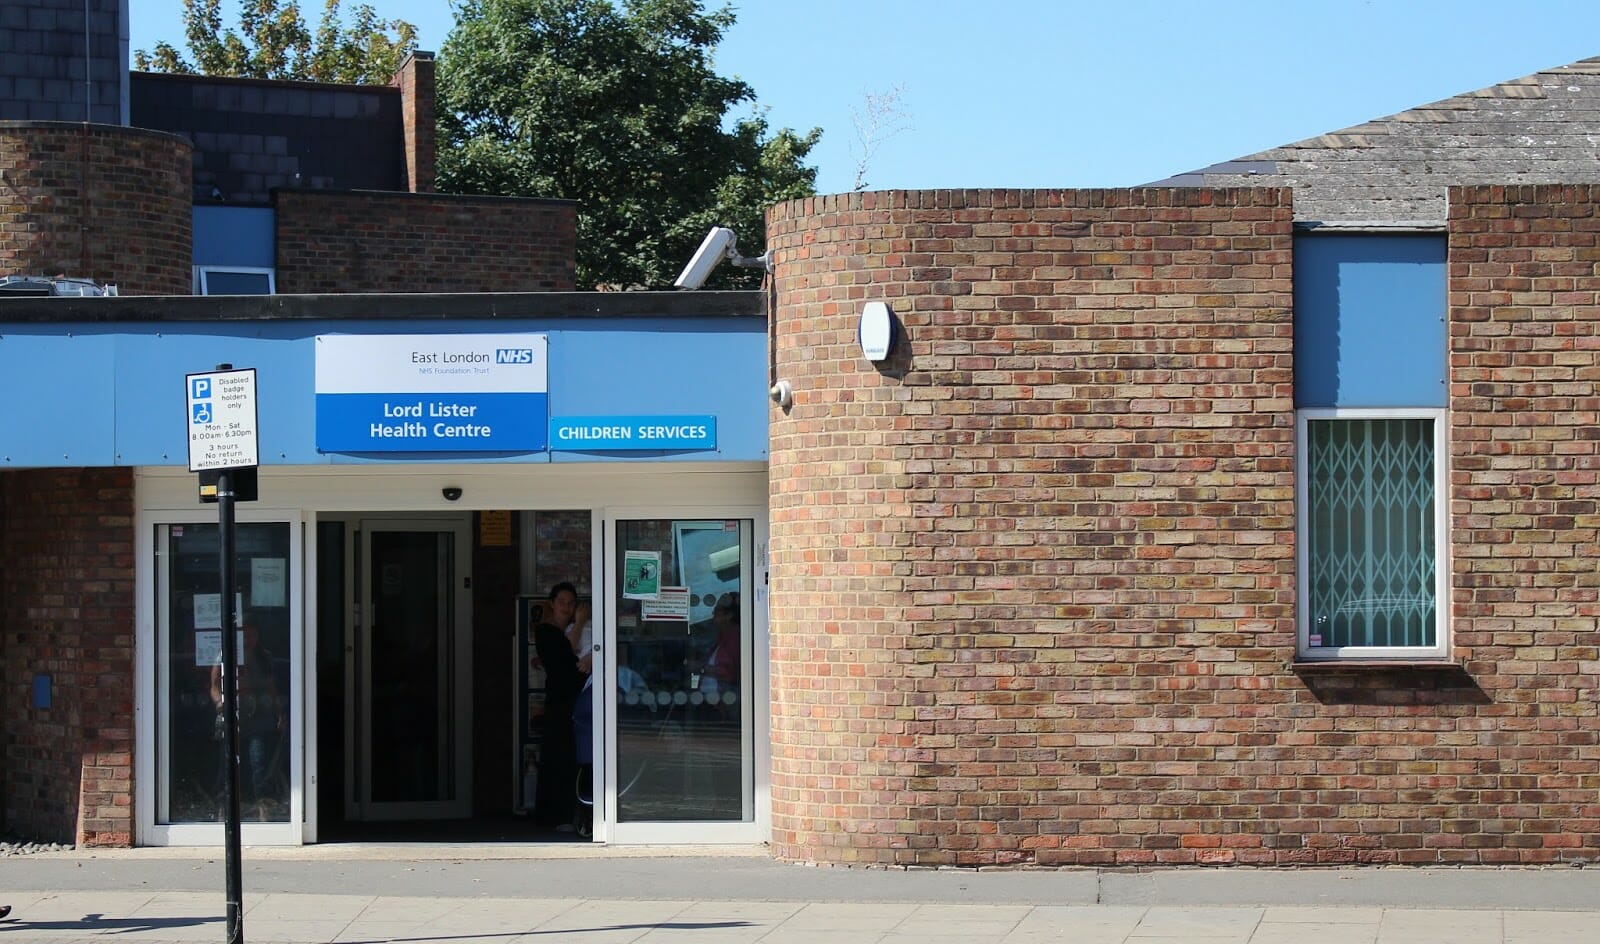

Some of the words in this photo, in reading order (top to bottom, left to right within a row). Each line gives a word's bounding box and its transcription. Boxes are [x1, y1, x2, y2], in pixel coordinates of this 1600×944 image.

[411, 351, 438, 363] East
[443, 351, 490, 363] London
[496, 350, 531, 363] NHS
[419, 367, 433, 375] NHS
[434, 367, 471, 375] Foundation
[473, 367, 490, 375] Trust
[219, 377, 249, 386] Disabled
[195, 380, 208, 398] P
[223, 385, 245, 394] badge
[221, 393, 247, 401] holders
[227, 401, 242, 410] only
[384, 402, 422, 418] Lord
[429, 402, 477, 418] Lister
[228, 422, 241, 430] Sat
[370, 422, 427, 438] Health
[433, 422, 492, 438] Centre
[558, 426, 631, 440] CHILDREN
[638, 425, 707, 439] SERVICES
[197, 460, 220, 468] within
[230, 457, 252, 465] hours
